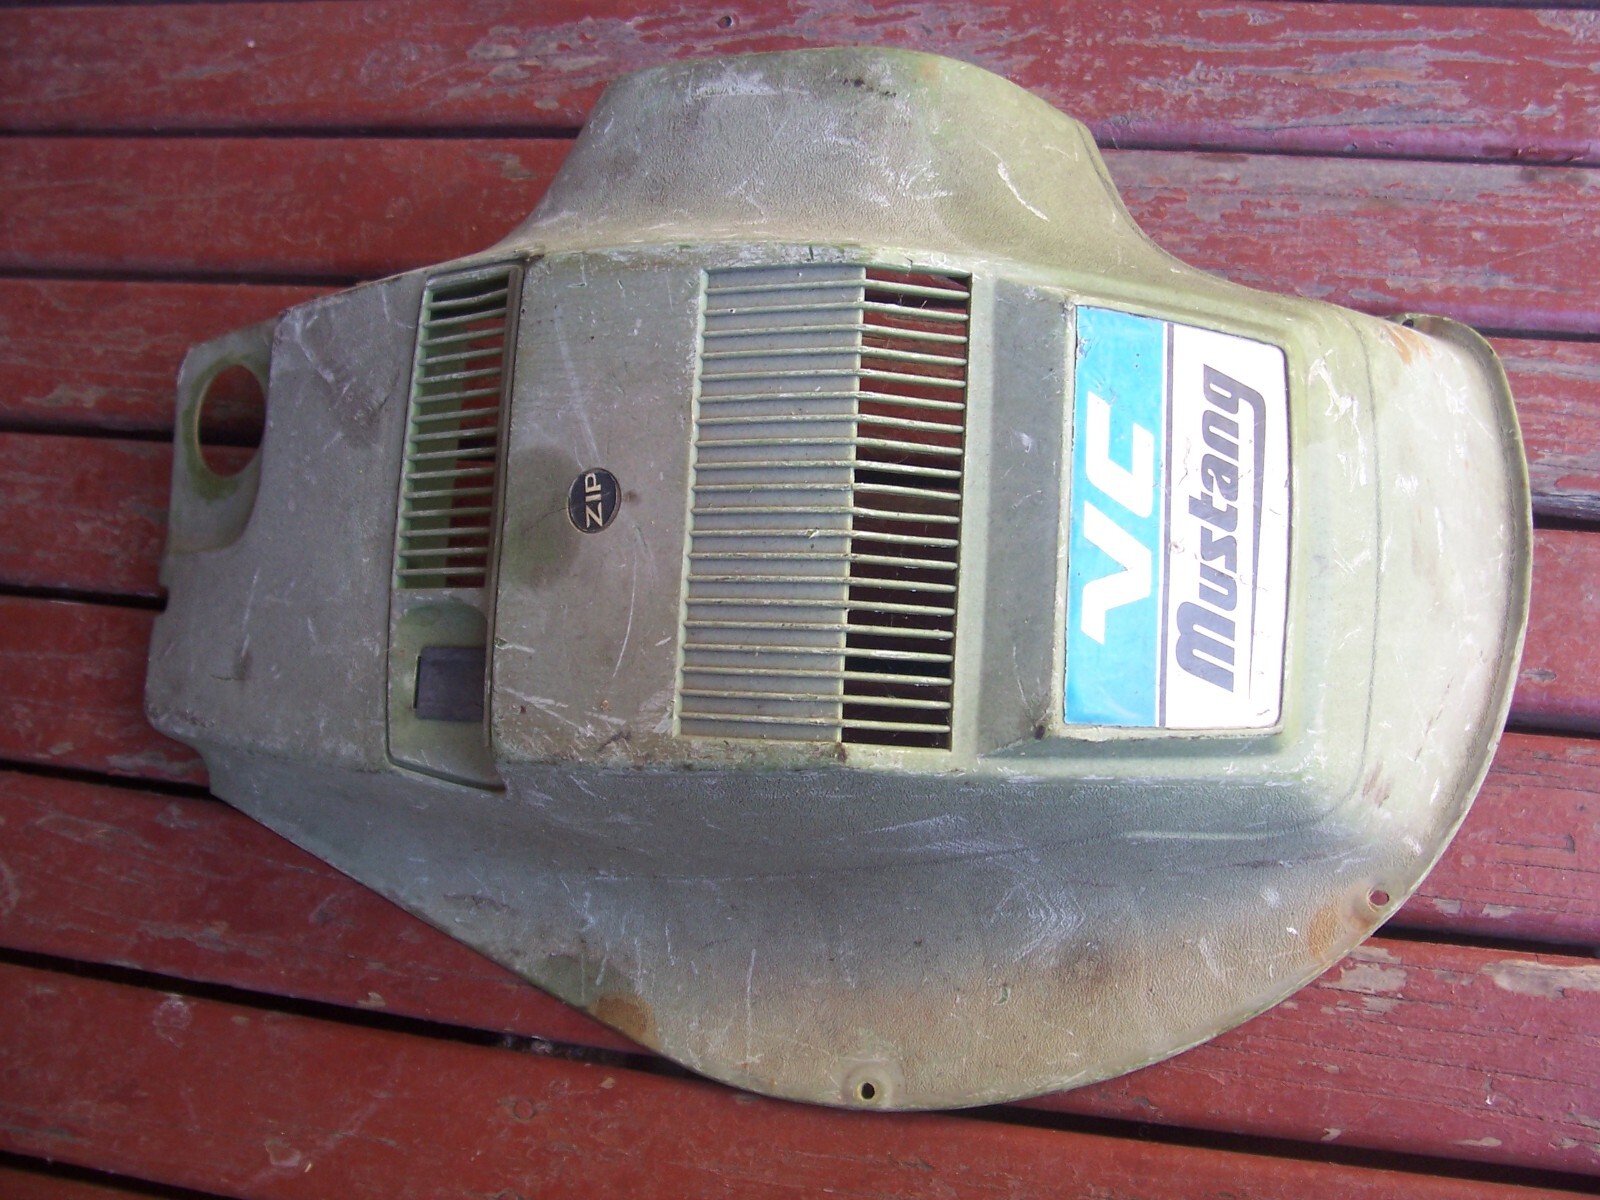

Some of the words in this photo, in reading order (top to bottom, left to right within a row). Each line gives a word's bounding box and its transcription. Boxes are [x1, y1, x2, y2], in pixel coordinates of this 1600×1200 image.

[585, 473, 603, 528] ZIP
[1081, 391, 1155, 645] VC
[1176, 363, 1266, 692] Mustang
